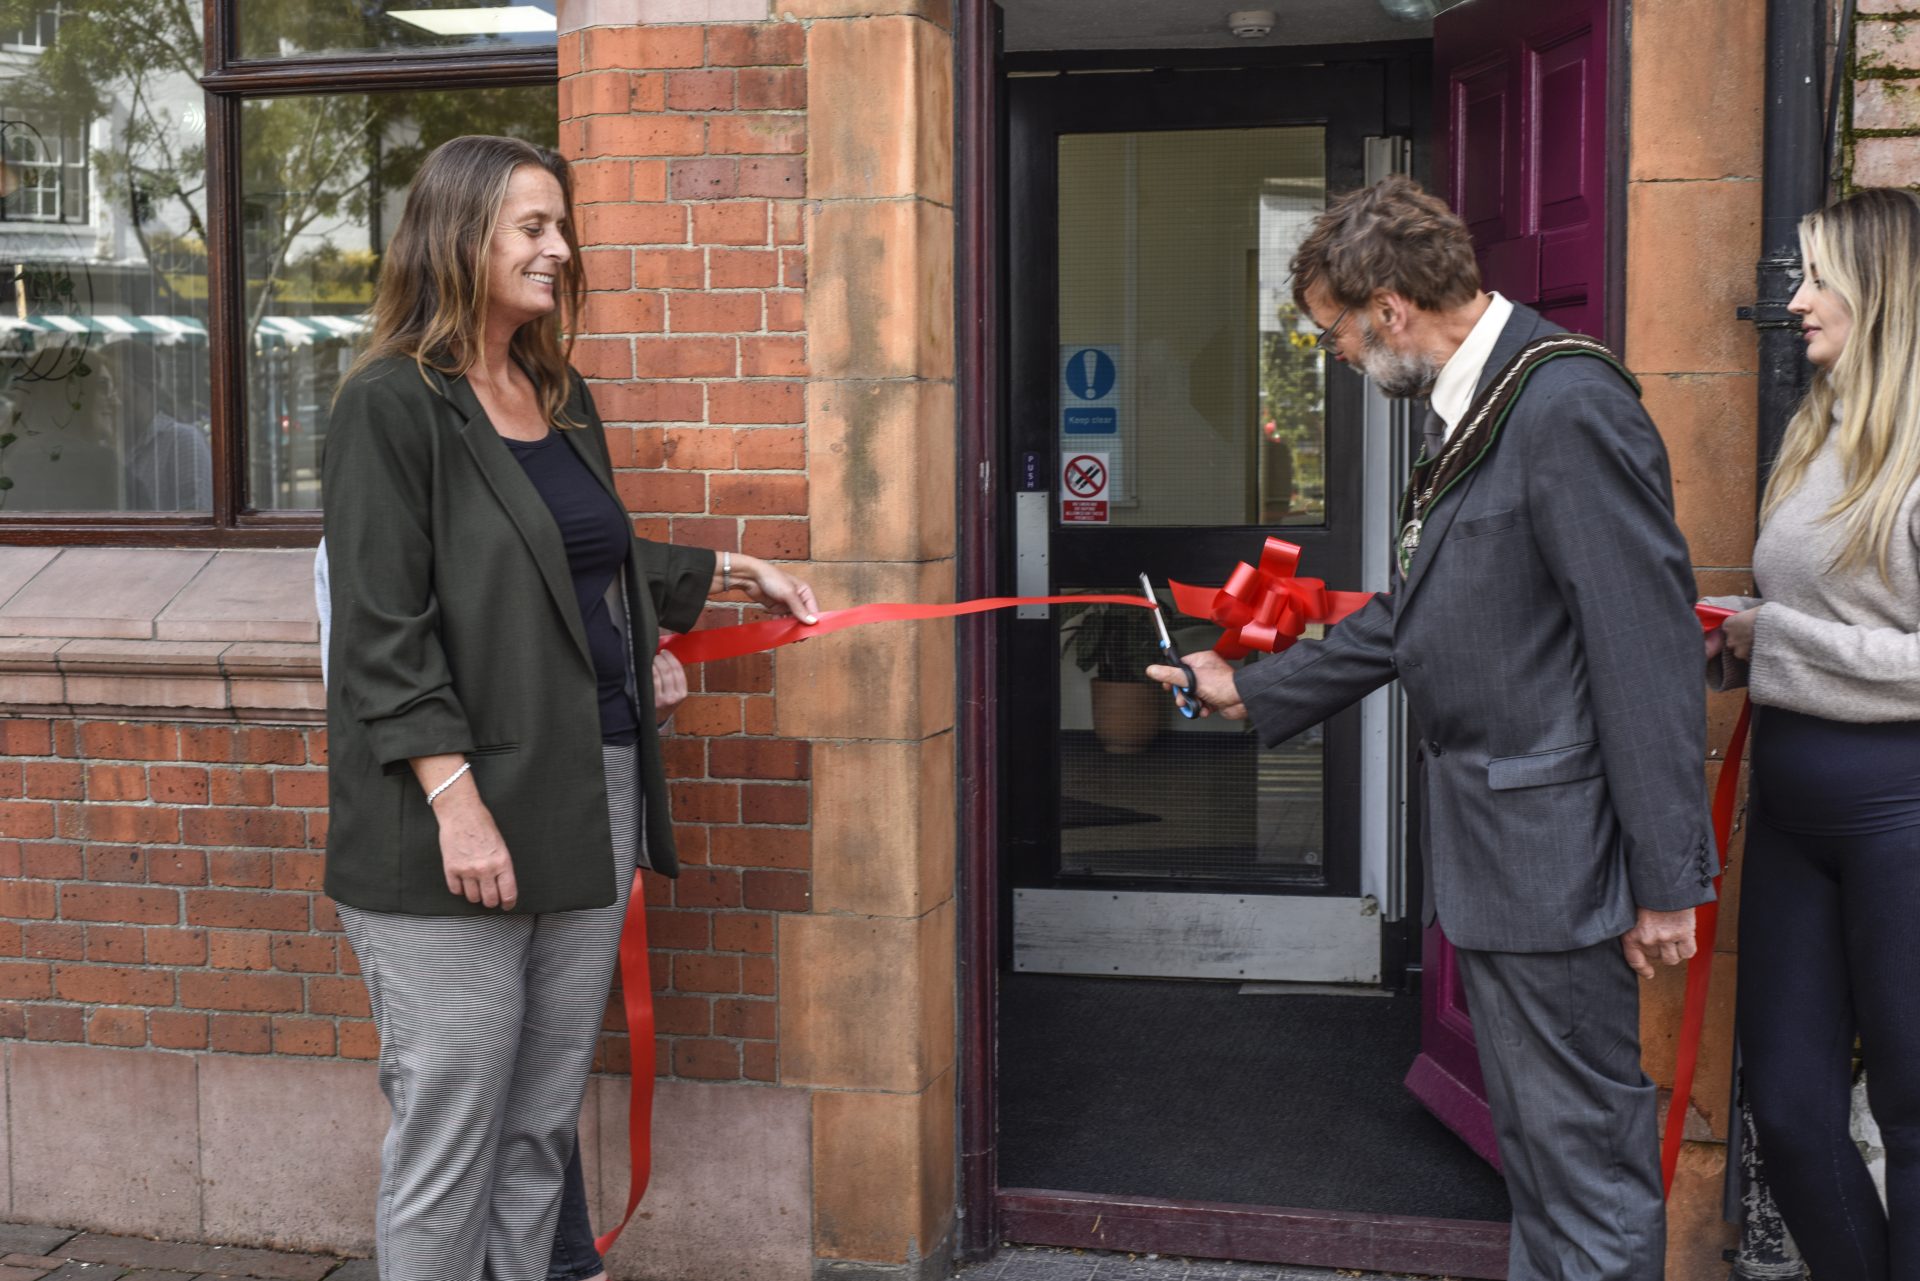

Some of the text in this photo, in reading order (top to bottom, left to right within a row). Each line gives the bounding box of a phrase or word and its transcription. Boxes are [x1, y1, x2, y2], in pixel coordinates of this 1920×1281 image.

[1069, 416, 1112, 425] Keep clear
[1027, 455, 1035, 488] PUSH
